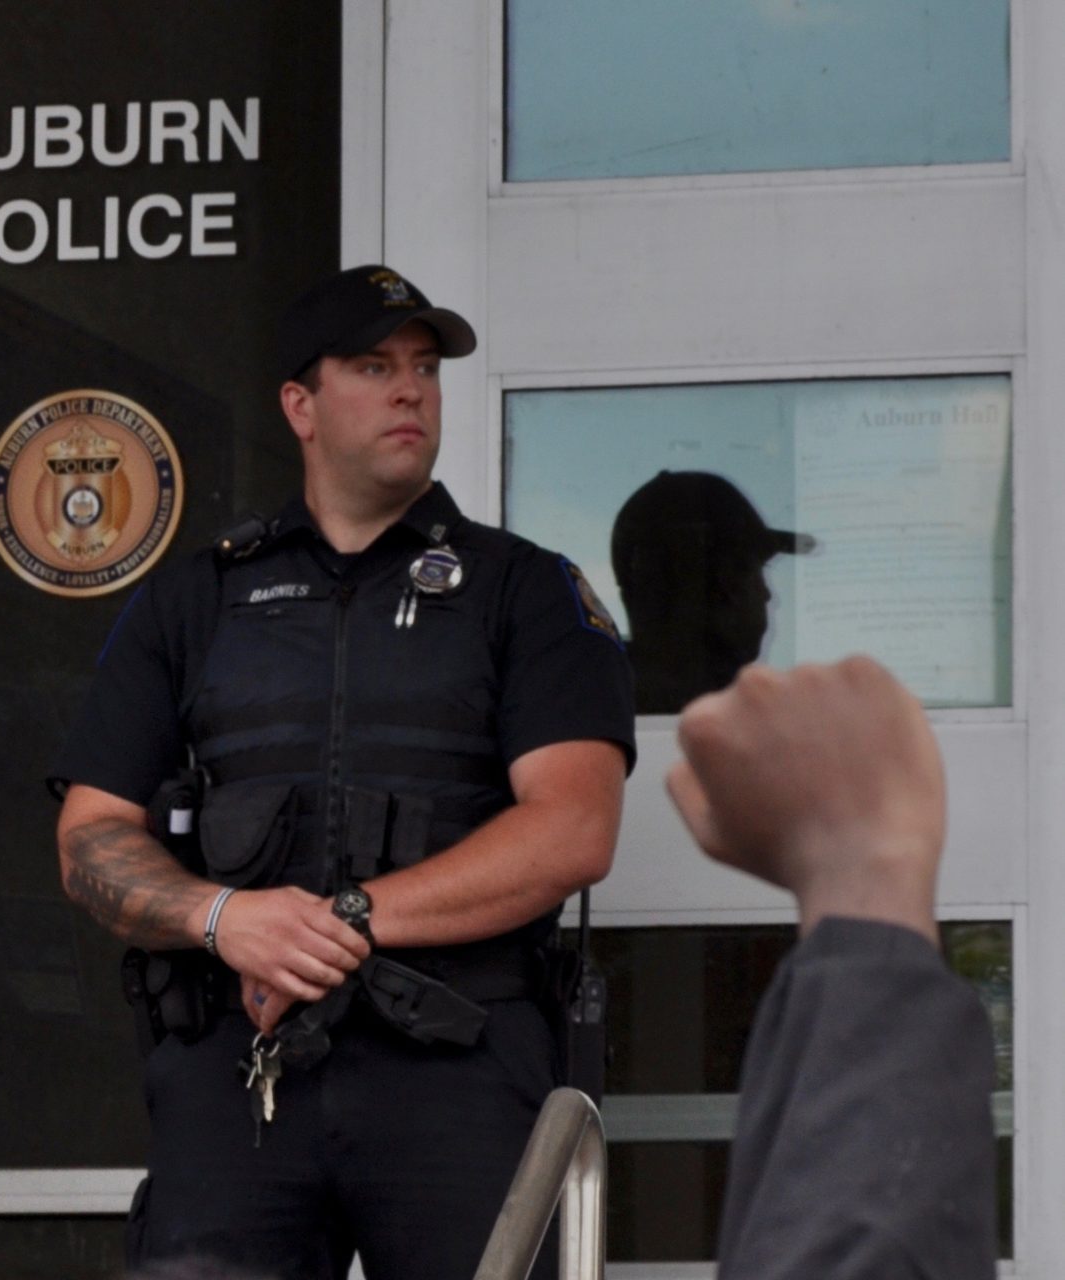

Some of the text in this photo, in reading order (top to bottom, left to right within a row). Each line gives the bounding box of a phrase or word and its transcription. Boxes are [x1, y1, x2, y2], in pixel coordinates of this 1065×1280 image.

[856, 406, 943, 428] Auburn
[0, 399, 168, 469] AUBURN POLICE DEPARTMENT
[54, 458, 112, 473] POLICE
